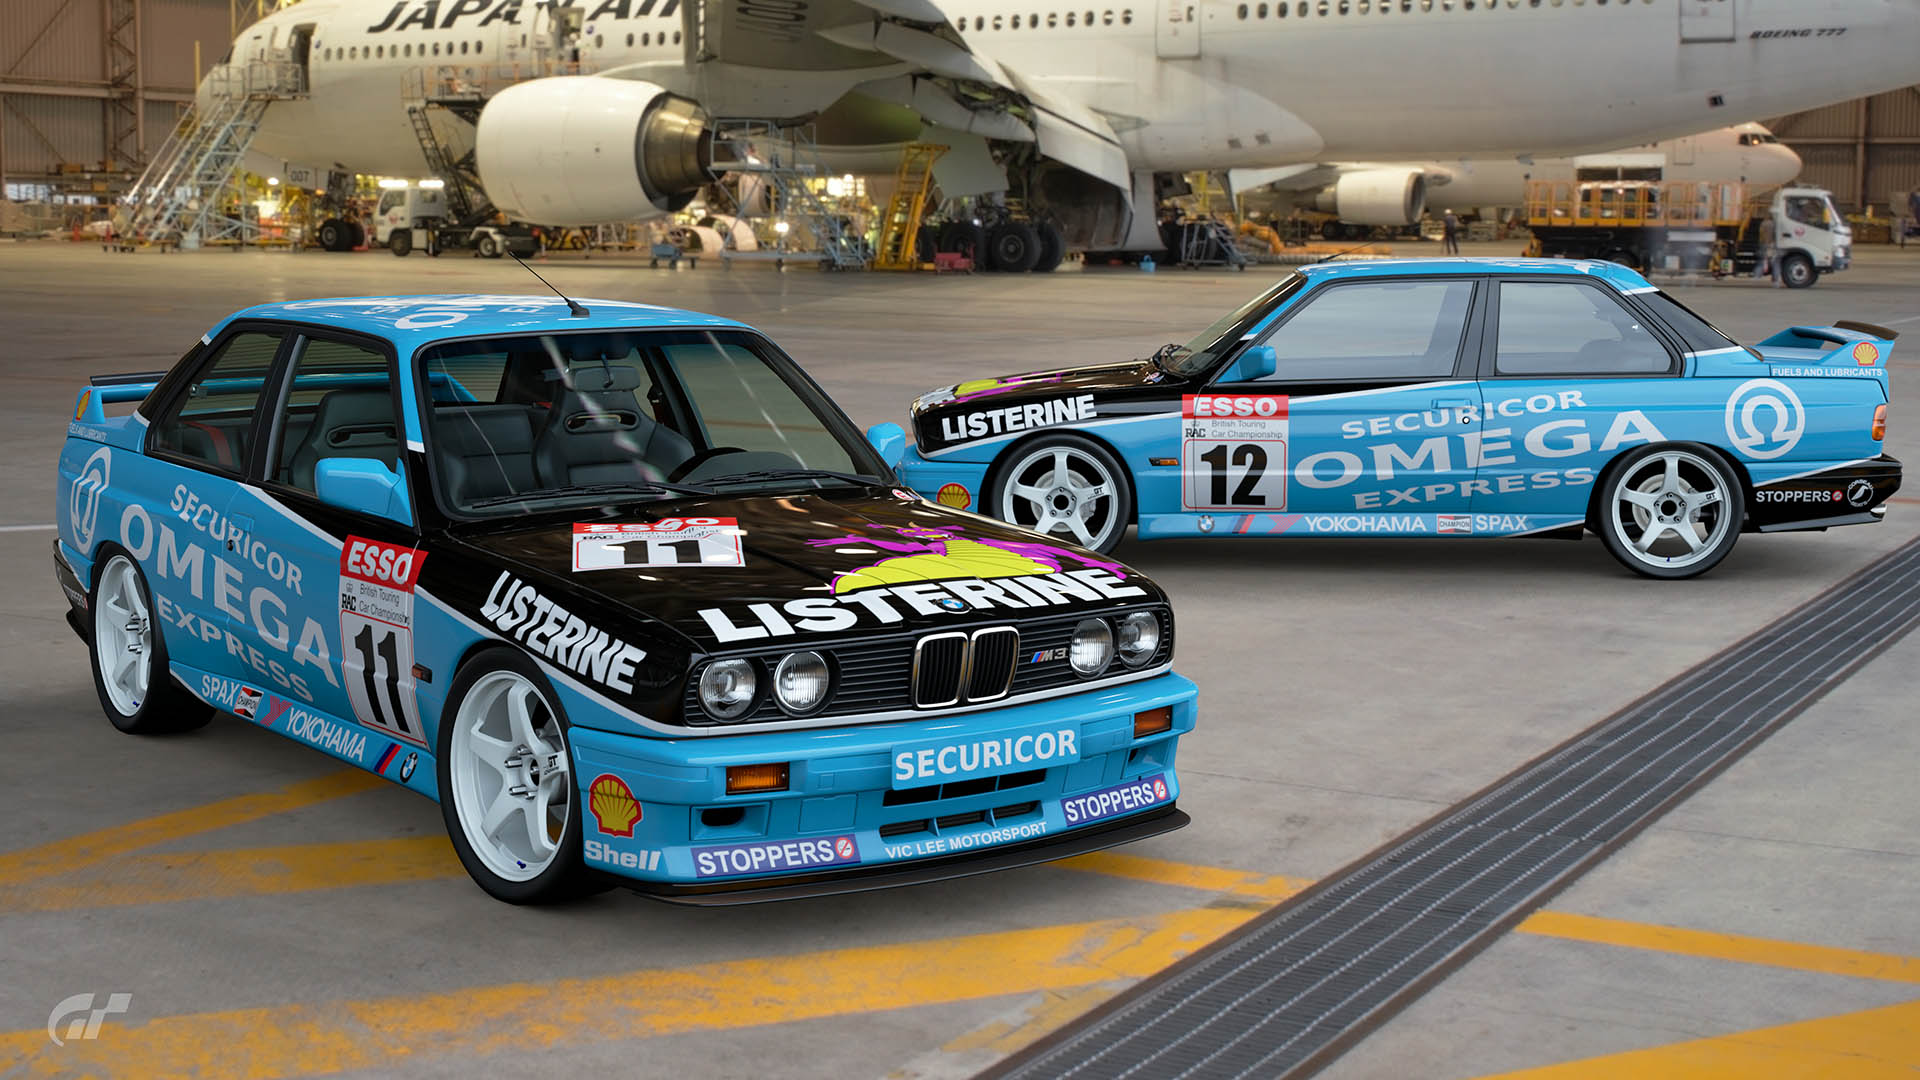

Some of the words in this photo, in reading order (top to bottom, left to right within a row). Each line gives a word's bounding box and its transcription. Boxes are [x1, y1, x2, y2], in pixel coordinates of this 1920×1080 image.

[1749, 29, 1812, 39] BOEING
[1816, 27, 1847, 37] 777
[1772, 367, 1801, 377] FUELS
[1803, 368, 1823, 377] AND
[1825, 368, 1883, 377] LUBRICANTS
[941, 394, 1097, 441] LISTERINE
[1193, 397, 1278, 416] ESSO
[1341, 390, 1587, 440] SECURICOR
[1185, 428, 1206, 438] RAC
[1227, 431, 1283, 439] Championship
[1238, 420, 1266, 429] Touring
[1294, 410, 1668, 489] OMEGA
[1200, 443, 1268, 506] 12
[1352, 467, 1594, 510] EXPRESS
[1756, 490, 1830, 503] STOPPERS
[170, 484, 303, 596] SECURICOR
[1304, 516, 1426, 532] YOKOHAMA
[1439, 519, 1470, 528] CHAMPION
[1476, 515, 1528, 531] SPAX
[347, 541, 413, 585] ESSO
[606, 539, 702, 565] 11
[120, 504, 340, 688] OMEGA
[342, 592, 357, 612] RAC
[359, 583, 378, 599] British
[378, 588, 400, 608] Touring
[359, 600, 370, 613] Car
[697, 568, 1148, 643] LISTERINE
[156, 592, 314, 702] EXPRESS
[479, 570, 647, 695] LISTERINE
[1038, 647, 1069, 663] M3
[202, 674, 240, 707] SPAX
[353, 622, 412, 735] 11
[286, 706, 367, 763] YOKOHAMA
[895, 729, 1078, 781] SECURICOR
[1064, 781, 1155, 823] STOPPERS
[585, 839, 661, 872] Shell
[697, 839, 835, 876] STOPPERS
[885, 844, 913, 859] VIC
[917, 839, 946, 856] LEE
[949, 822, 1048, 850] MOTORSPORT
